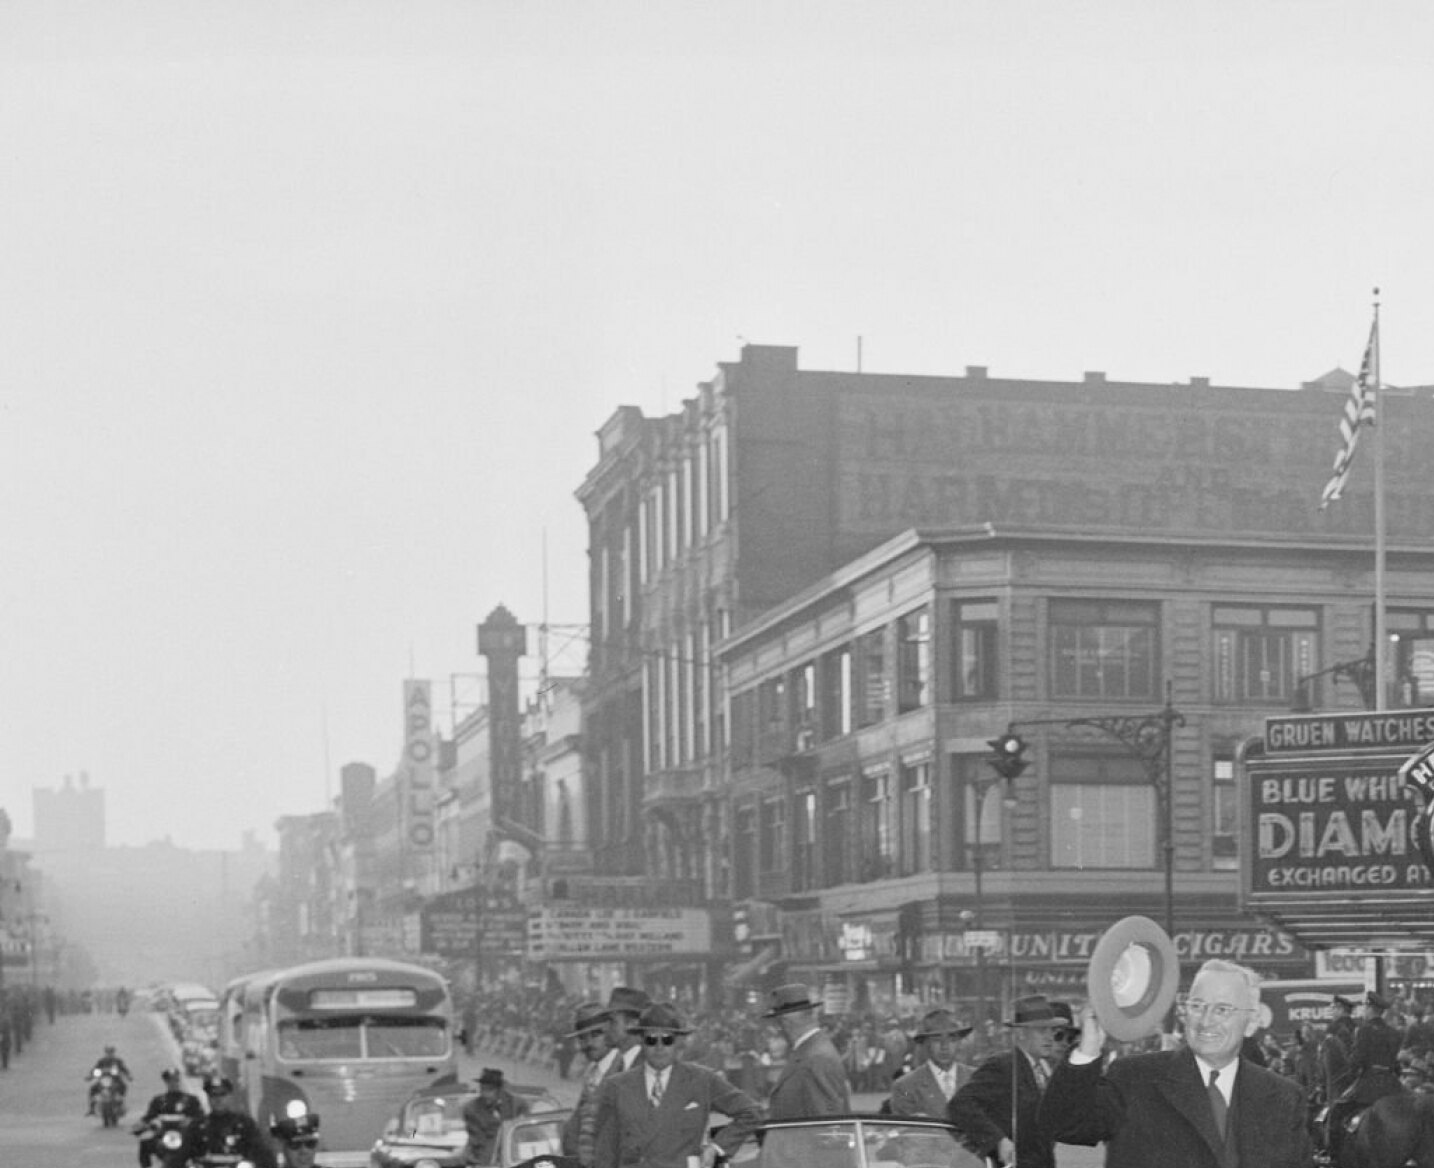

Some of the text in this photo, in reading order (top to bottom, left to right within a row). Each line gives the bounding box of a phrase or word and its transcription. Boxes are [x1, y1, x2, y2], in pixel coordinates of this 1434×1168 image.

[1269, 722, 1336, 747] GRUEN
[408, 686, 435, 847] APOLLO
[1261, 776, 1398, 804] BLUE WHI
[1258, 809, 1407, 859] DIAM
[1267, 864, 1397, 886] EXCHANGED
[1011, 932, 1100, 958] UNIT
[1176, 931, 1294, 958] CIGARS
